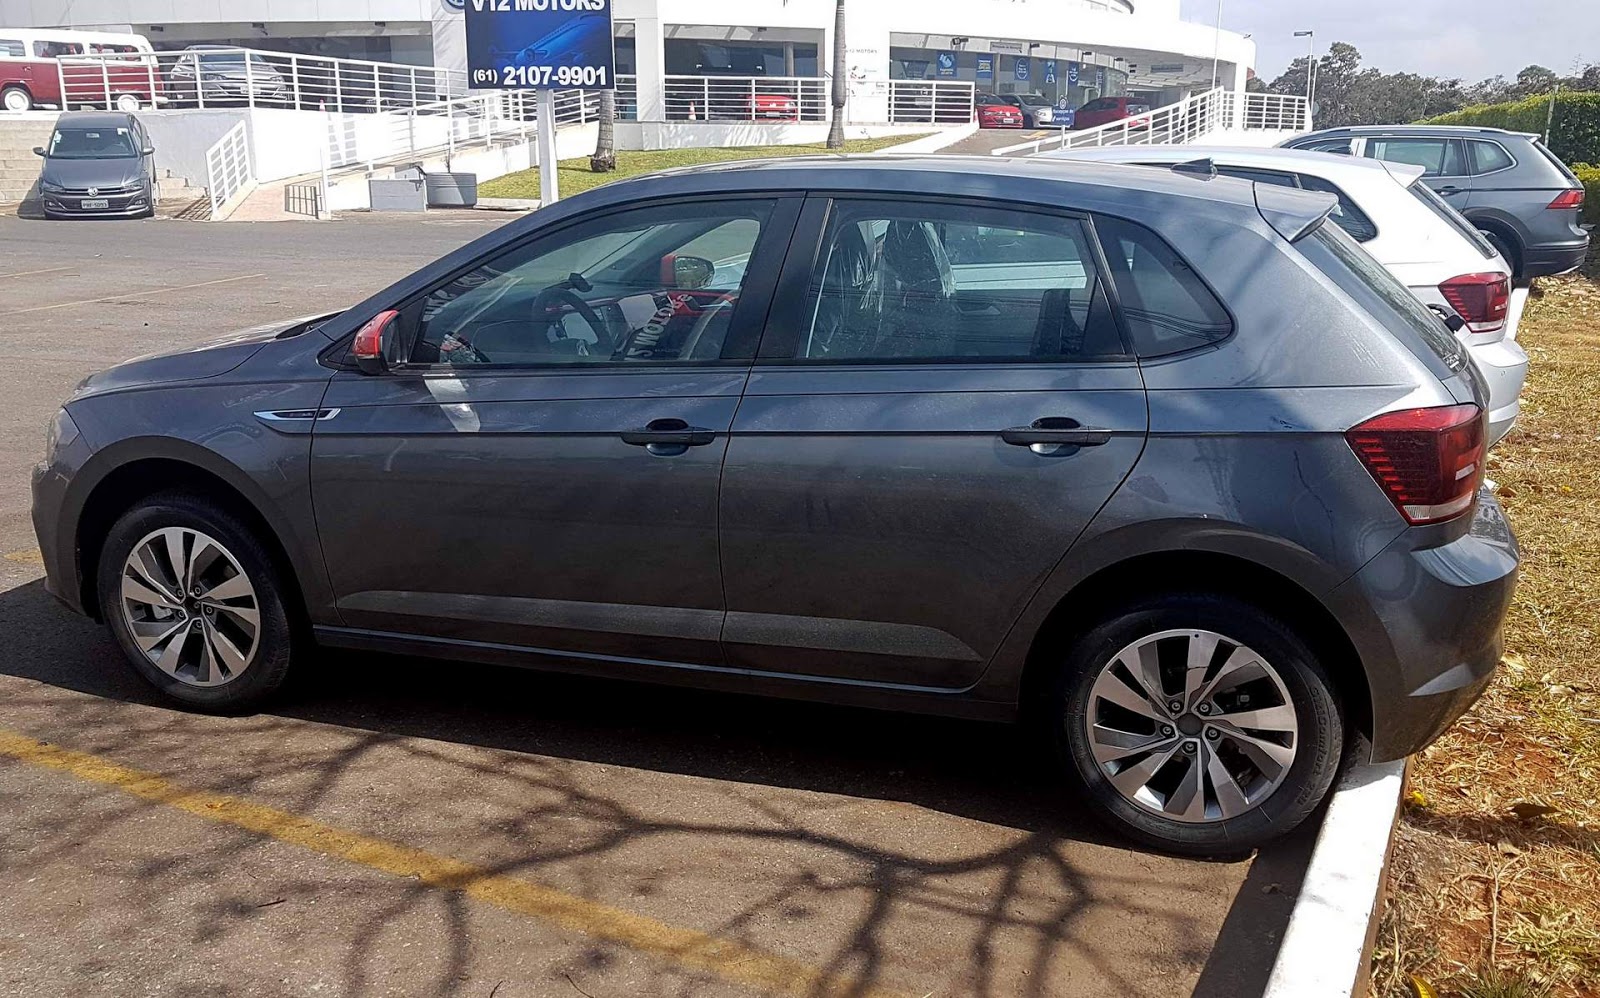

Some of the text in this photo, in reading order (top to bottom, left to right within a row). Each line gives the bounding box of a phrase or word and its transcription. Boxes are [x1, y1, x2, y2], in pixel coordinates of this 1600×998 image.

[472, 0, 605, 11] V12 MOTORS
[473, 65, 607, 86] (61) 2107-9901
